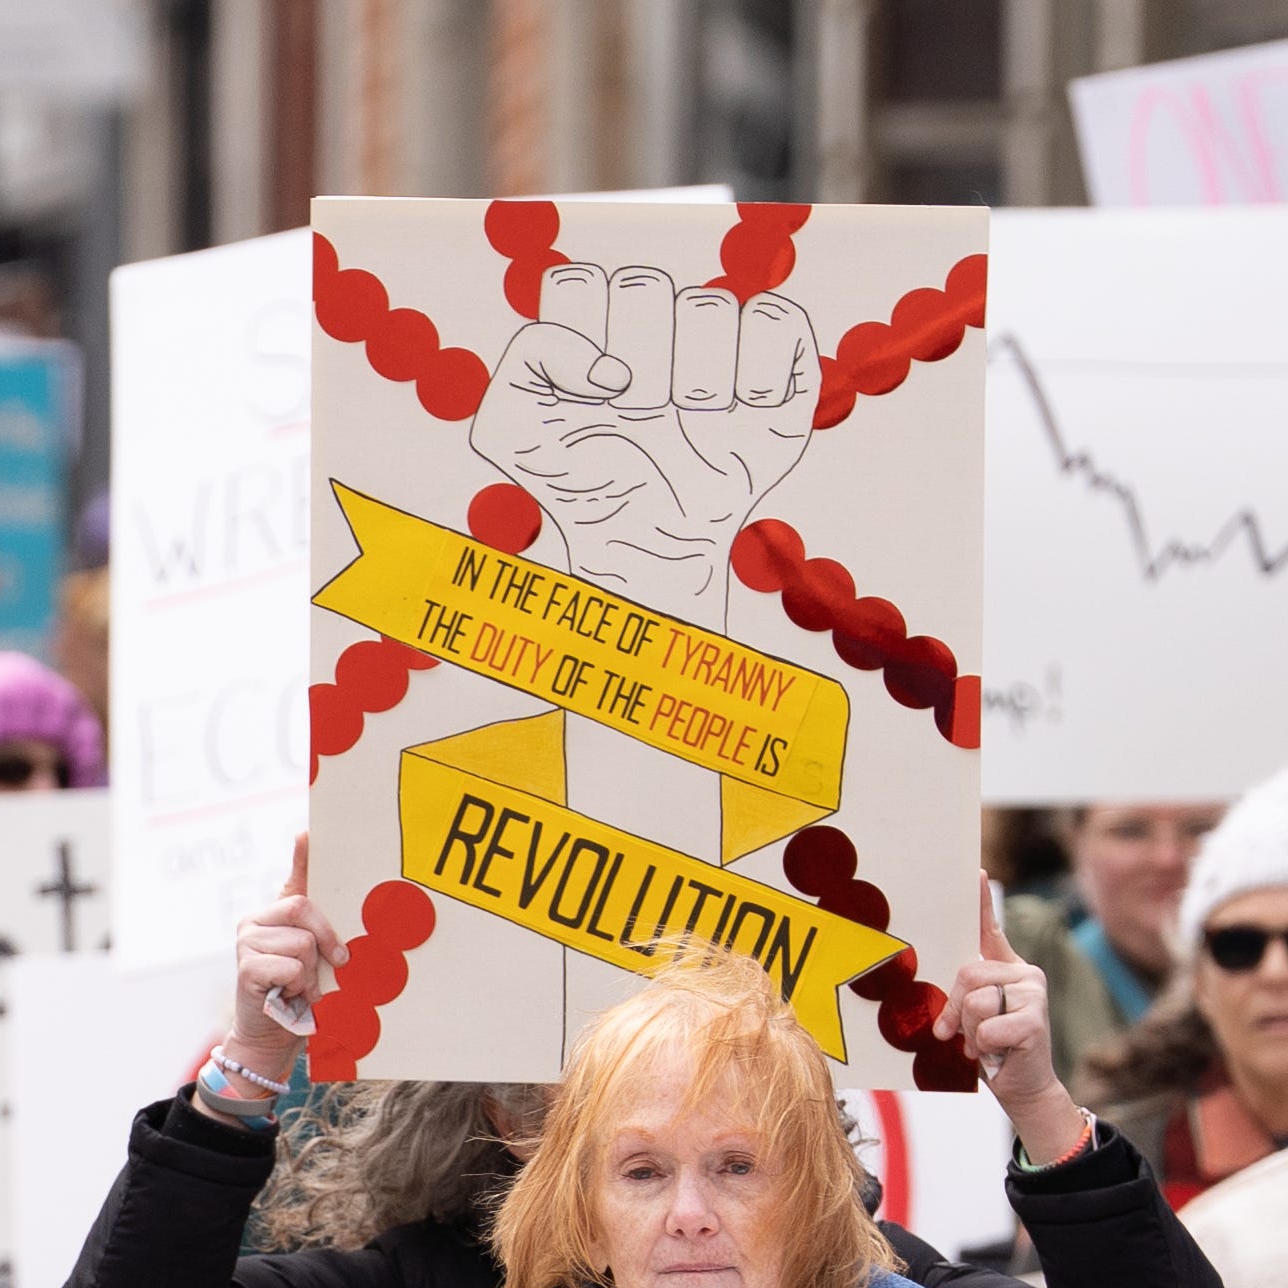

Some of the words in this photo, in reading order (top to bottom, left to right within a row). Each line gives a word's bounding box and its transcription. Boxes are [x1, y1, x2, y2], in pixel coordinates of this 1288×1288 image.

[417, 599, 472, 655] THE
[470, 621, 554, 685] DUTY
[551, 654, 594, 699] OF
[596, 670, 652, 725] THE
[649, 694, 757, 766] PEOPLE
[754, 737, 788, 778] IS
[453, 546, 484, 592] IN
[488, 559, 544, 614] THE
[542, 583, 620, 646] FACE
[618, 616, 659, 658] OF
[660, 628, 797, 713] TYRANNY
[433, 792, 819, 1004] REVOLUTION
